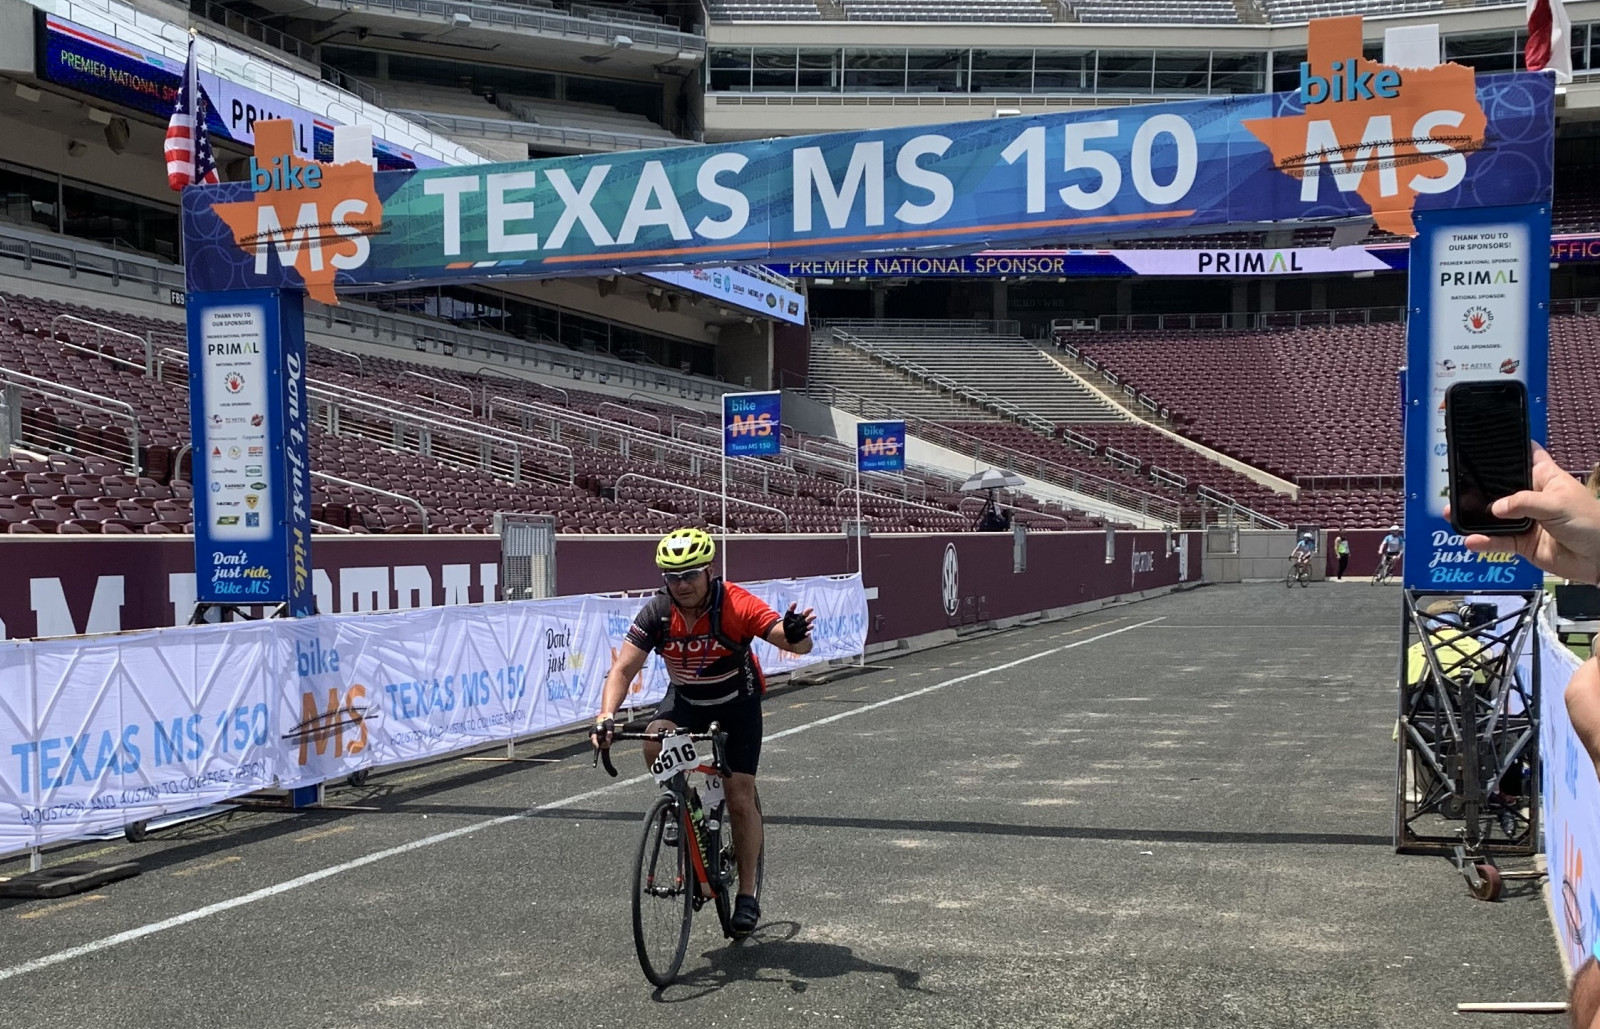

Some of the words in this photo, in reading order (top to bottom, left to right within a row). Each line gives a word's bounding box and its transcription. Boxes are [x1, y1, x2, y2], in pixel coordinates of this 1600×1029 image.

[61, 50, 106, 79] PREMIER
[108, 67, 159, 98] NATIONAL
[1300, 59, 1402, 105] bike
[1300, 110, 1467, 202] MS
[250, 155, 322, 192] bike
[423, 152, 750, 256] TEXAS
[793, 134, 954, 232] MS
[1001, 114, 1198, 213] 150
[254, 200, 370, 275] MS
[1467, 242, 1512, 250] SPONSORS!
[789, 258, 869, 274] PREMIER
[875, 257, 970, 274] NATIONAL
[975, 256, 1065, 274] SPONSOR
[1199, 251, 1303, 274] PRIMAL
[1440, 269, 1518, 286] PRIMAL
[1462, 306, 1475, 322] LEFT
[1476, 305, 1494, 321] HAND
[208, 342, 260, 355] PRIMAL
[287, 352, 305, 444] Don't
[732, 399, 756, 411] bike
[864, 426, 884, 436] bike
[287, 447, 306, 523] just
[212, 550, 248, 565] Don't
[1428, 548, 1474, 568] just
[211, 566, 242, 582] just
[242, 566, 272, 580] ride,
[1430, 566, 1475, 583] Bike
[1478, 566, 1517, 583] MS
[213, 580, 243, 594] Bike
[245, 580, 270, 594] MS
[545, 624, 571, 649] Don't
[664, 639, 726, 653] OYOTA
[296, 637, 340, 677] bike
[385, 675, 455, 721] TEXAS
[461, 669, 490, 709] MS
[496, 663, 526, 701] 150
[297, 683, 368, 766] MS
[467, 719, 476, 731] TO
[11, 724, 142, 794] TEXAS
[154, 713, 205, 768] MS
[216, 702, 269, 754] 150
[652, 743, 696, 774] 6516
[705, 778, 720, 791] 16
[21, 803, 87, 826] HOUSTON
[90, 795, 116, 811] AND
[119, 785, 160, 804] AUSTIN
[162, 780, 179, 794] TO
[180, 771, 228, 792] COLLEGE
